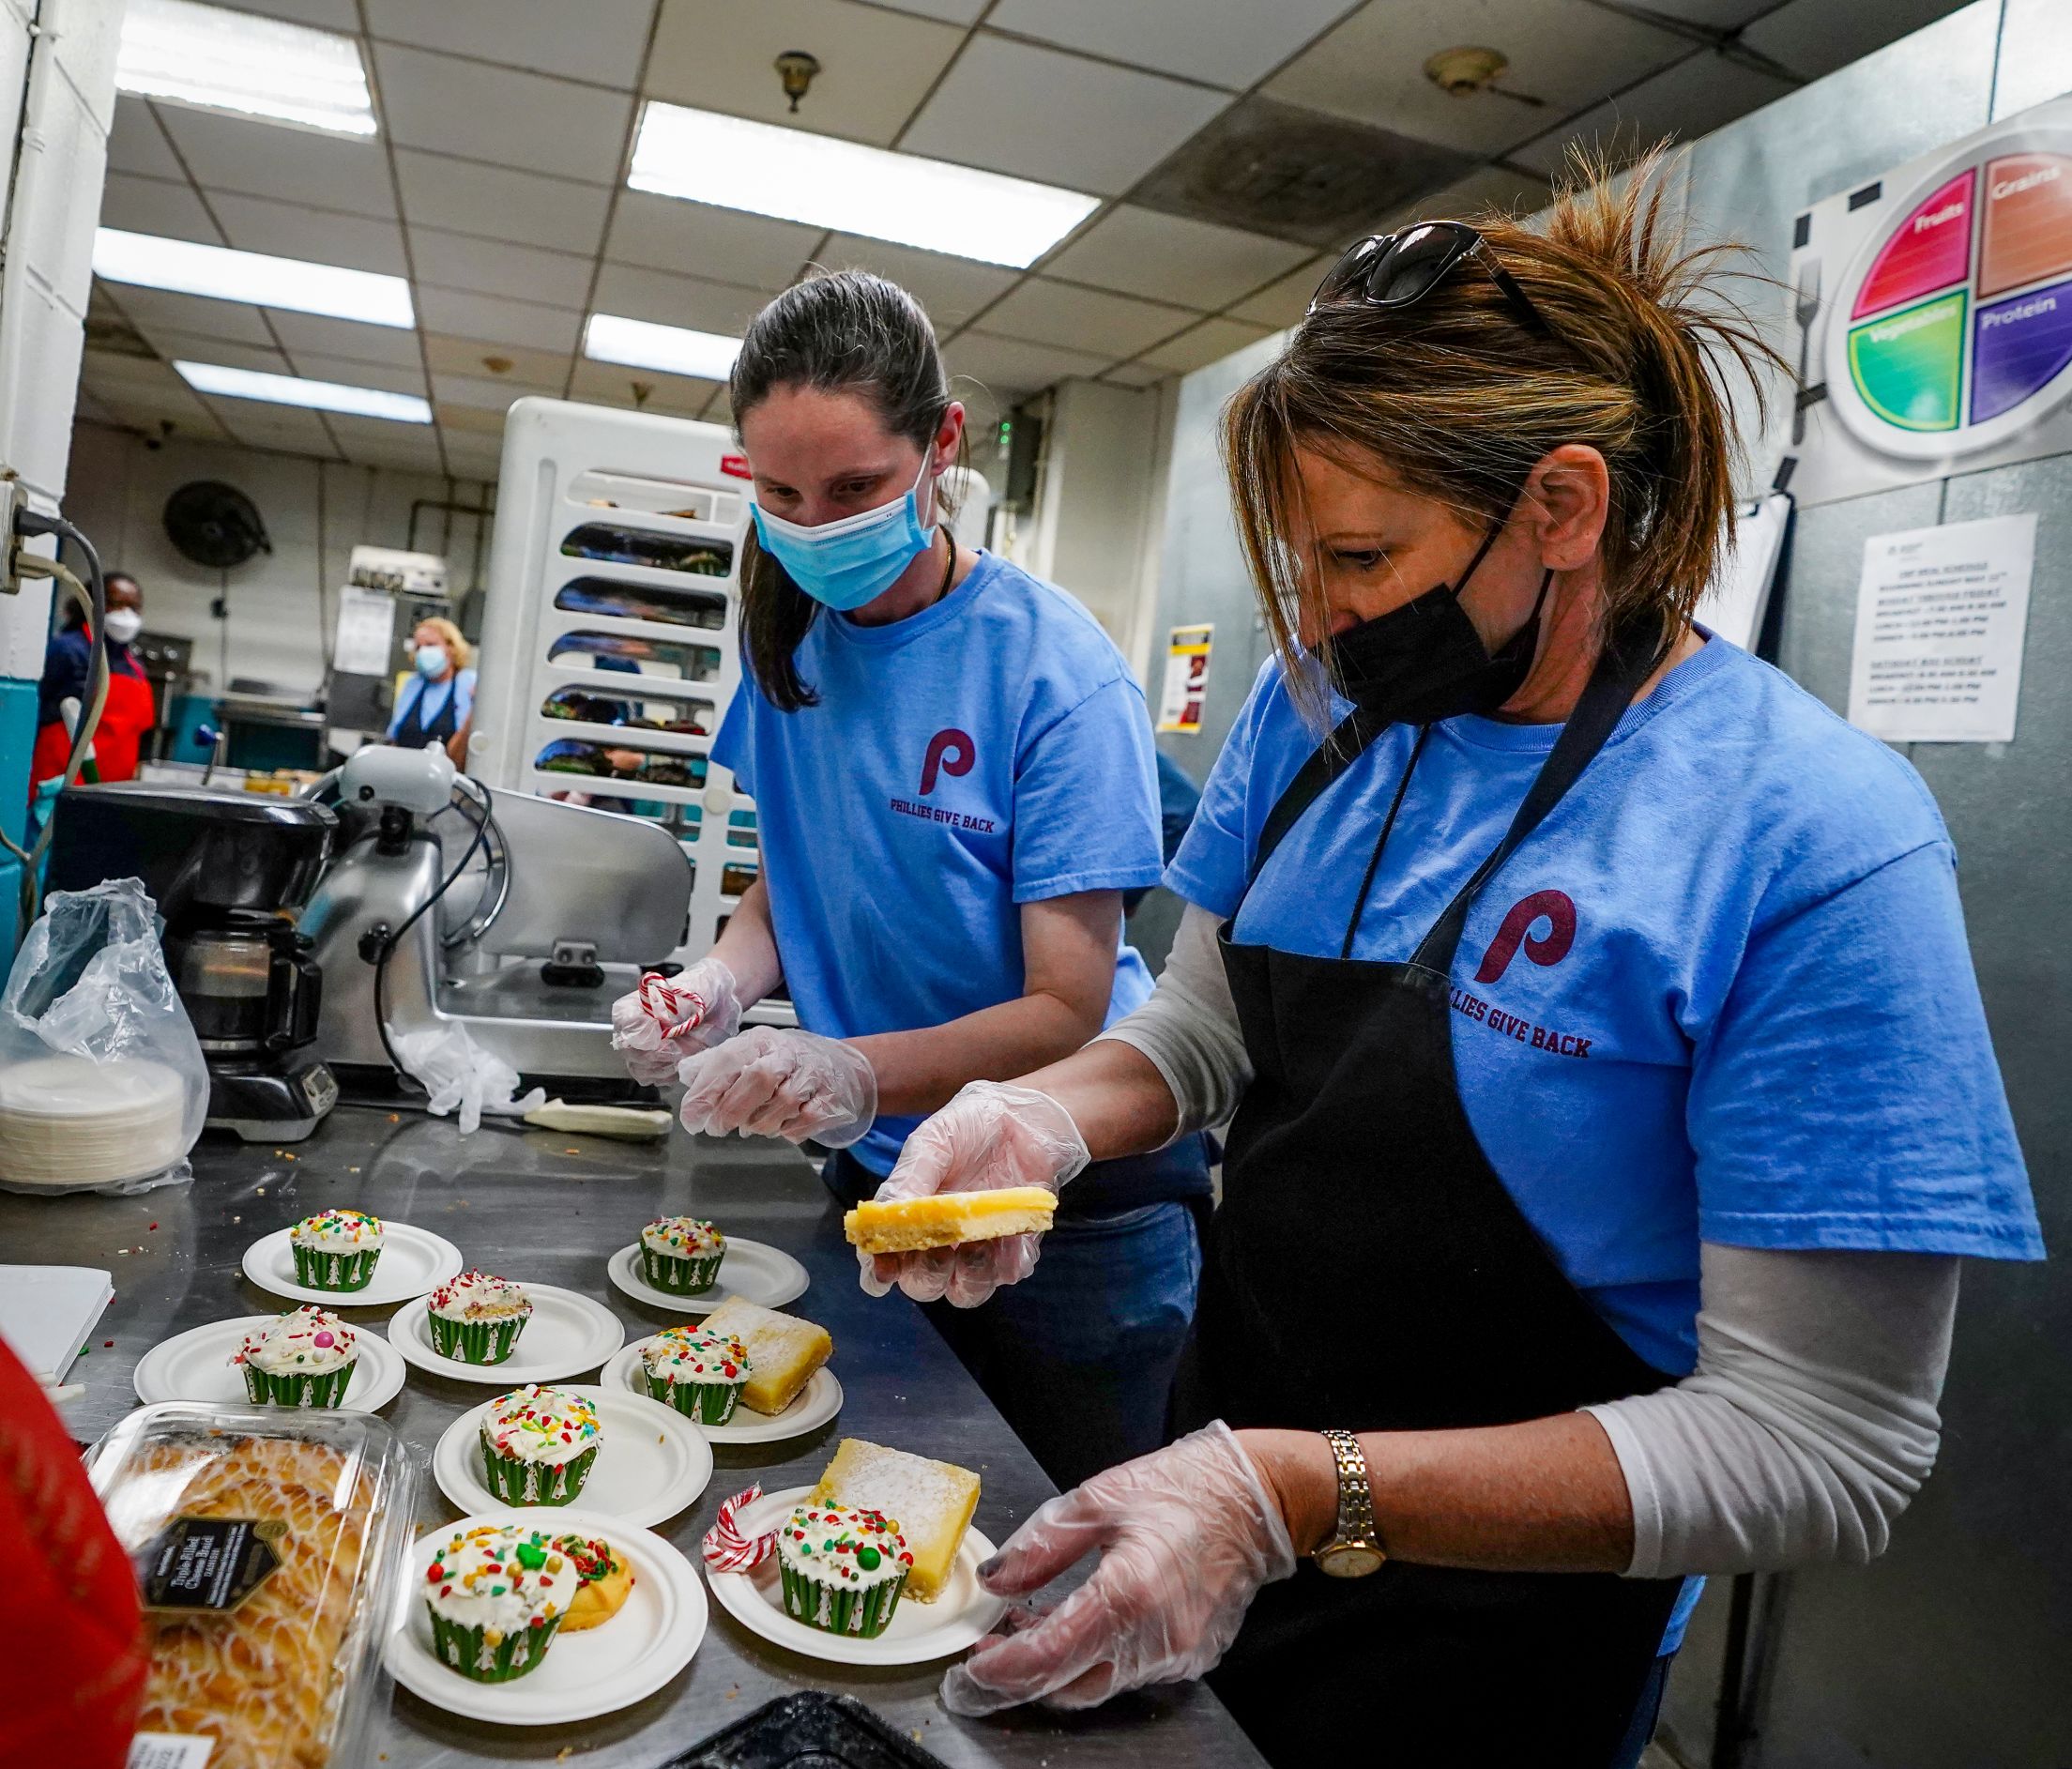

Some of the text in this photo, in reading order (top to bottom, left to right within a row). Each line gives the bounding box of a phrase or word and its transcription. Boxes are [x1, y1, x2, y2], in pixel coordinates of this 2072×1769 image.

[1991, 165, 2062, 201] Grains
[1913, 201, 1965, 234] Fruits
[1982, 295, 2058, 329] Protein
[891, 799, 995, 833] PHILLIES GIVE BACK
[1487, 1008, 1530, 1043] GIVE
[1531, 1026, 1592, 1059] BACK
